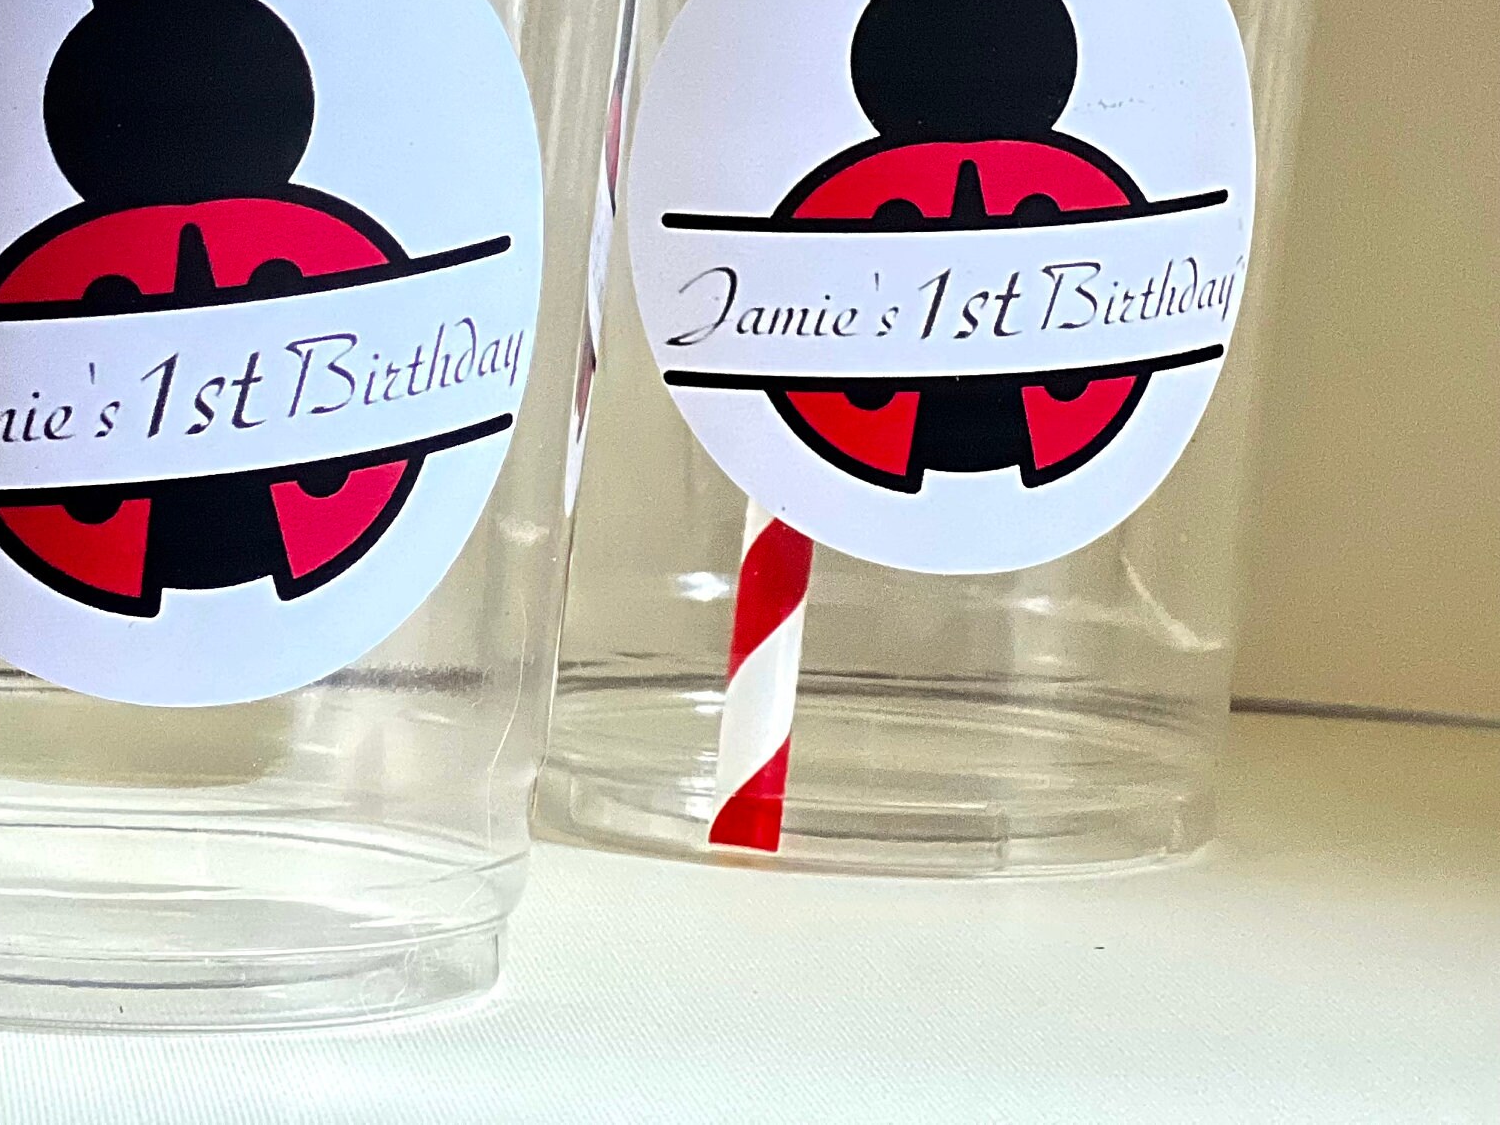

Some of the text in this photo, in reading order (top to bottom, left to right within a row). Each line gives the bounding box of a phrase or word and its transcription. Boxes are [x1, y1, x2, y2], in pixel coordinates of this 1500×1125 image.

[665, 256, 1236, 347] Jamie's 1st Birthday
[140, 352, 266, 438] 1st
[285, 317, 525, 419] Birthday
